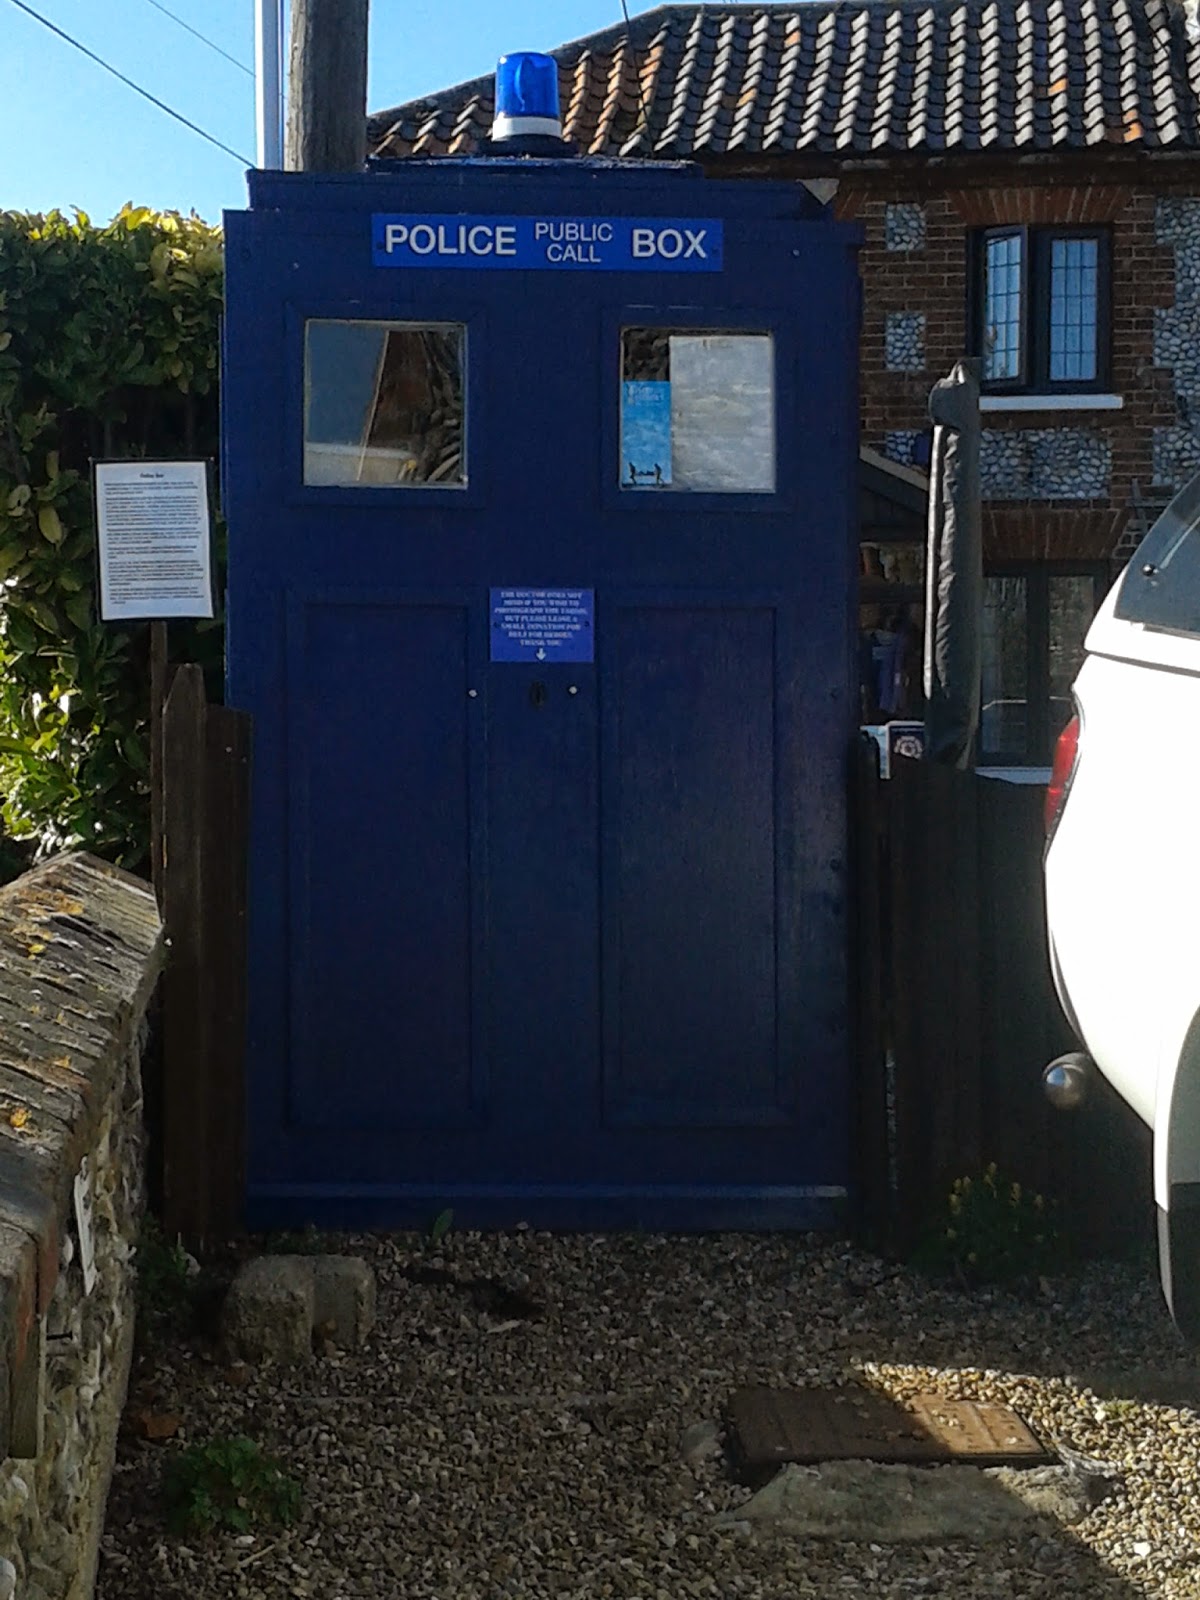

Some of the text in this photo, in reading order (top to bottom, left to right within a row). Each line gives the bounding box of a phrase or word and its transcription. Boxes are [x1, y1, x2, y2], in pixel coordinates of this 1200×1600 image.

[384, 224, 518, 256] POLICE
[534, 222, 613, 242] PUBLIC
[546, 243, 601, 263] CALL
[632, 228, 708, 259] BOX
[516, 591, 546, 599] DOCTOR
[569, 599, 579, 607] TO
[501, 622, 525, 630] SMALL
